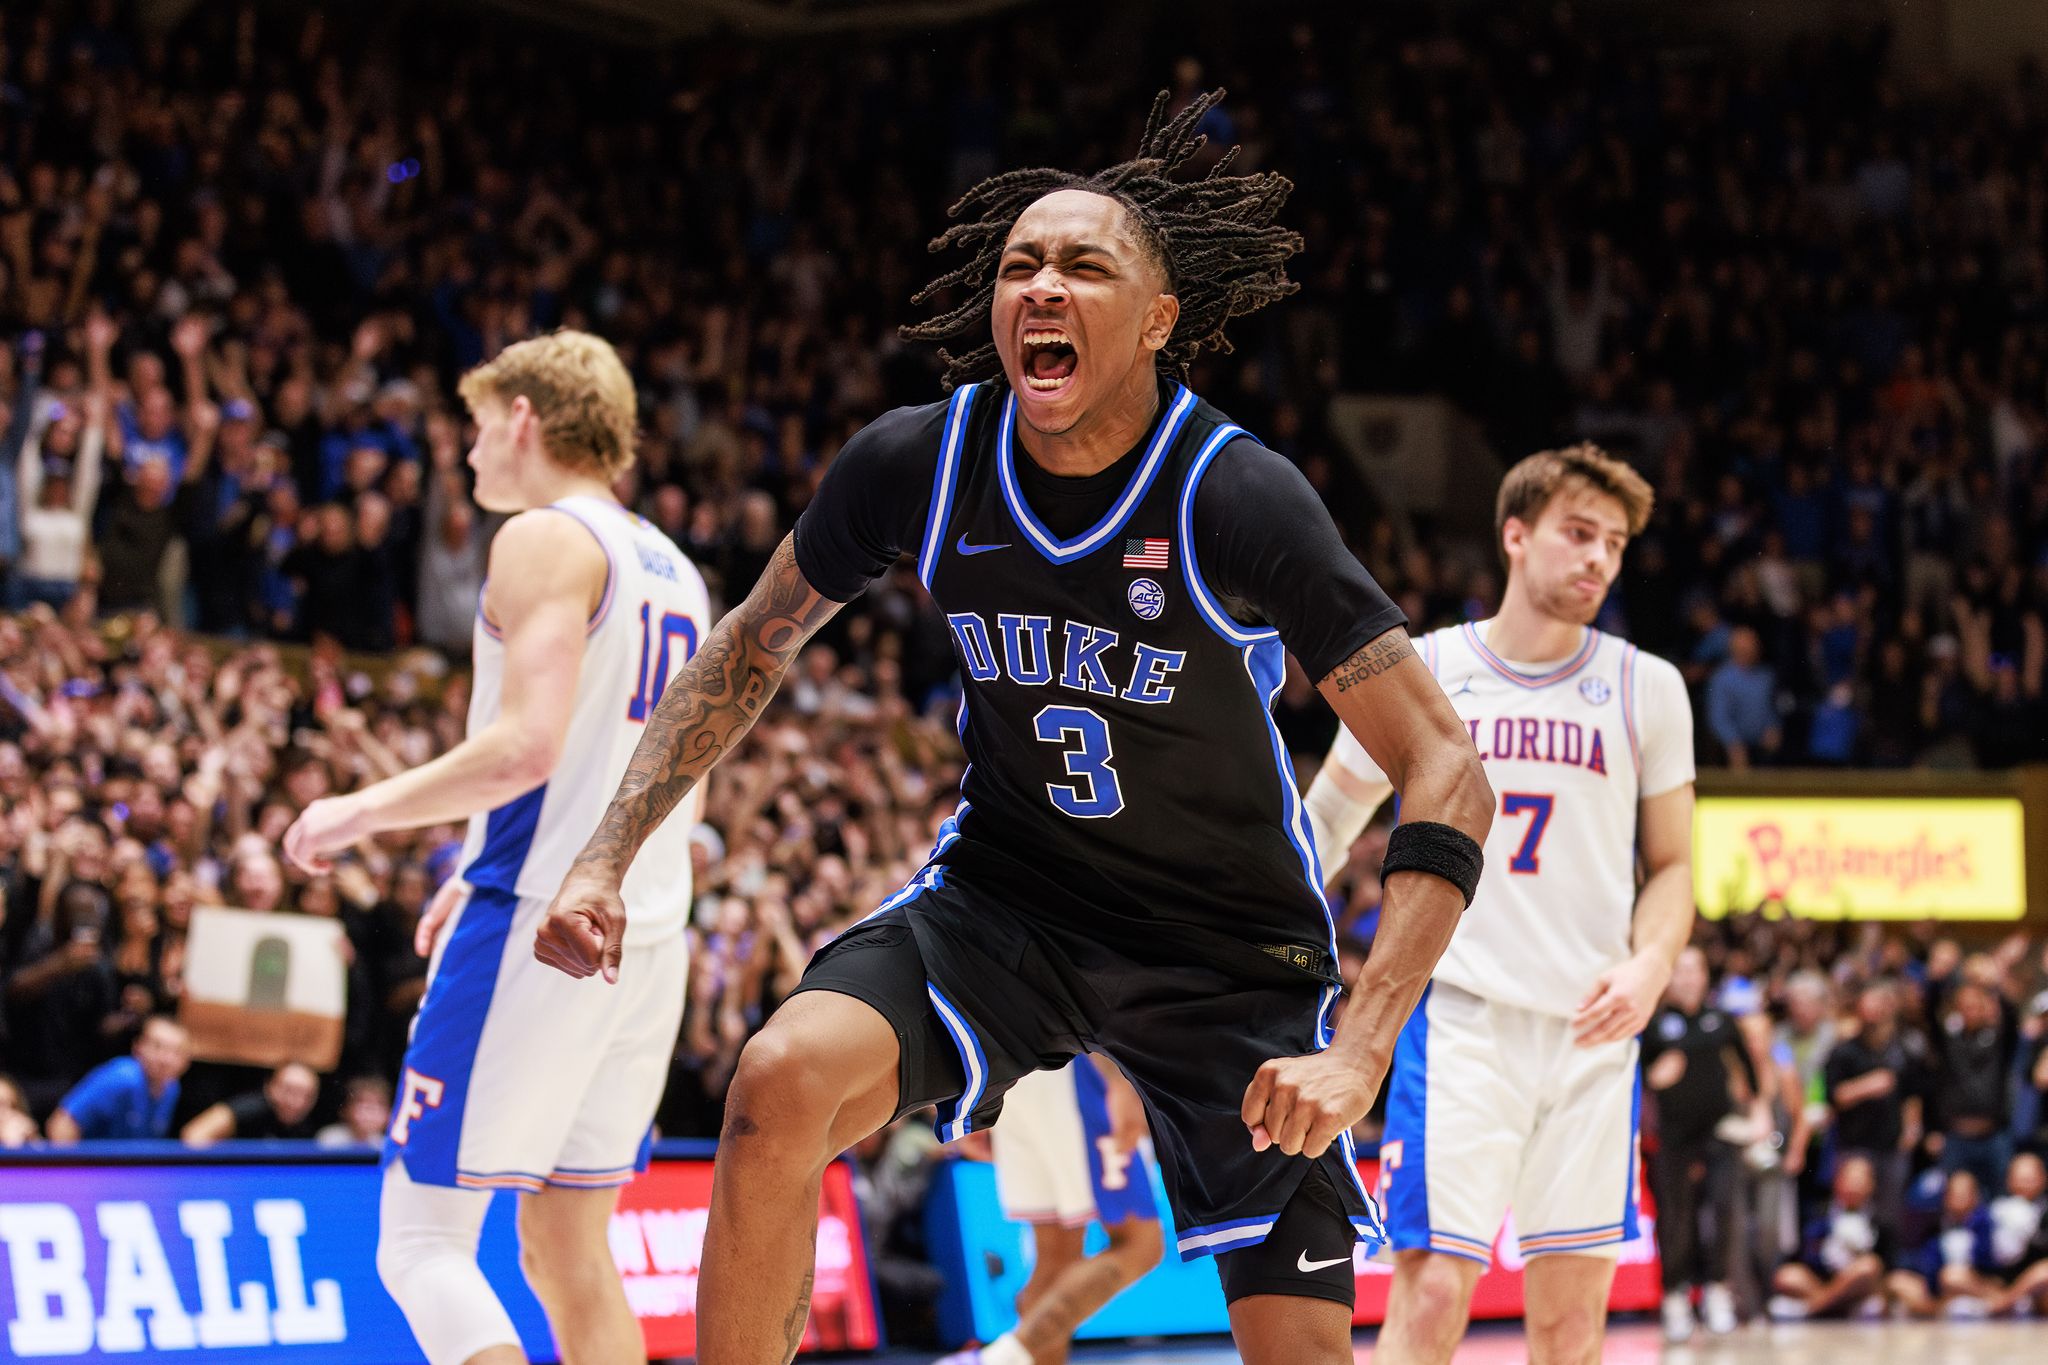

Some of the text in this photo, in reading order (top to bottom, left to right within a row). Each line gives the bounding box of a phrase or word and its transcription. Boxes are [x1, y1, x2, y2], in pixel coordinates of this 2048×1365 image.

[1132, 592, 1163, 605] ACC
[627, 601, 698, 724] 10
[947, 612, 1187, 704] DUKE
[1033, 704, 1125, 818] 3
[1464, 717, 1608, 776] LORIDA
[1502, 792, 1554, 874] 7
[1293, 953, 1309, 968] 46
[390, 1067, 445, 1146] F
[0, 1200, 347, 1357] BALL
